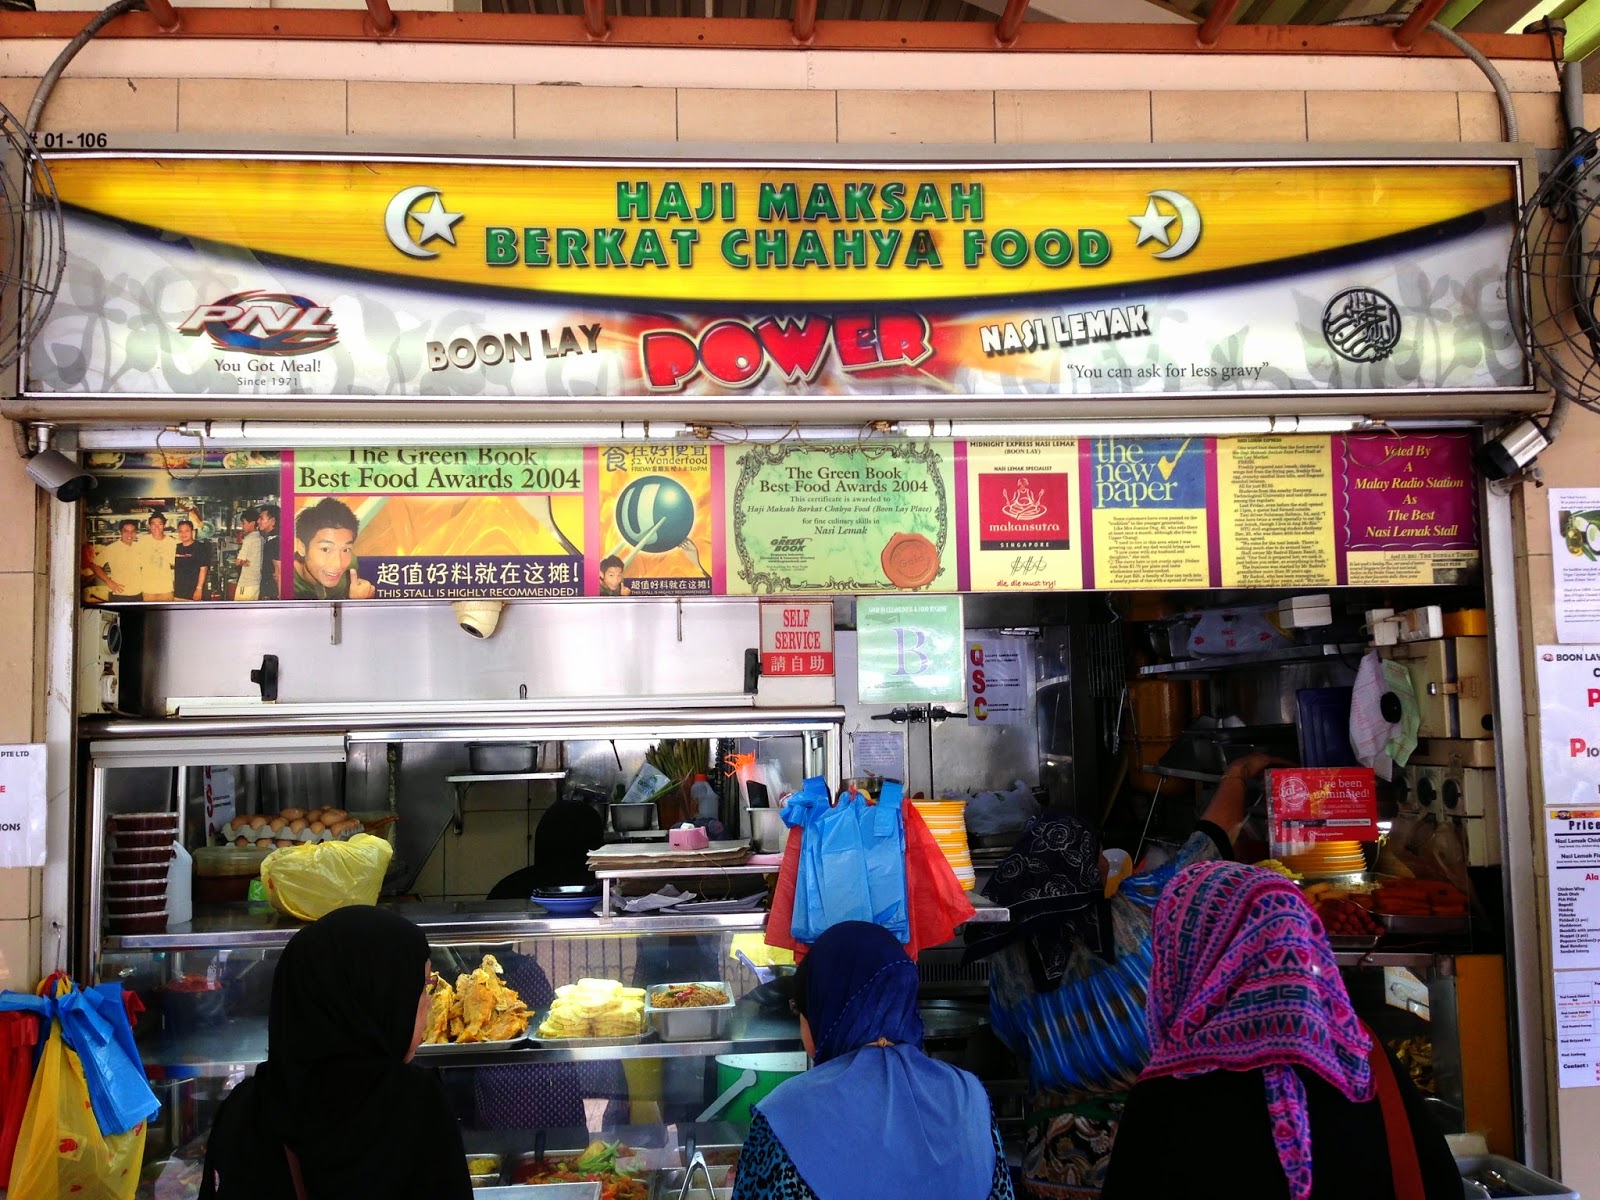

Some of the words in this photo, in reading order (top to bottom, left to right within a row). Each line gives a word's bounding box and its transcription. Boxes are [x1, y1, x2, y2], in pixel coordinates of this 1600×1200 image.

[44, 132, 107, 148] 01-106
[615, 181, 736, 222] HAJI
[757, 182, 984, 223] MAKSAH
[484, 226, 700, 268] BERKAT
[720, 227, 944, 268] CHAHYA
[963, 227, 1112, 267] FOOD
[176, 303, 338, 338] PNL
[979, 318, 1050, 358] NASI
[1052, 304, 1152, 348] LEMAK
[426, 331, 533, 371] BOON
[540, 322, 602, 360] LAY
[640, 312, 936, 391] POWER
[214, 358, 242, 373] You
[247, 358, 276, 373] Got
[281, 358, 322, 373] Meal!
[1067, 363, 1115, 379] “You
[1117, 367, 1134, 378] can
[1137, 363, 1161, 378] ask
[1163, 364, 1188, 378] for
[1191, 363, 1217, 377] less
[1221, 361, 1269, 382] gravy”
[237, 377, 267, 387] Since
[270, 376, 299, 387] 1971
[396, 449, 468, 465] Green
[477, 449, 538, 465] Book
[1096, 436, 1143, 463] the
[1384, 445, 1413, 456] Voted
[1416, 445, 1431, 458] By
[645, 457, 707, 465] Wonderfood
[1403, 461, 1413, 472] A
[299, 466, 350, 489] Best
[358, 466, 418, 489] Food
[426, 466, 513, 489] Awards
[521, 466, 580, 489] 2004
[785, 467, 812, 479] The
[818, 467, 860, 479] Green
[865, 467, 902, 479] Book
[1096, 463, 1157, 482] new
[759, 480, 790, 493] Best
[795, 480, 830, 493] Food
[835, 480, 887, 493] Awards
[892, 480, 928, 493] 2004
[1354, 478, 1389, 491] Malay
[1392, 477, 1424, 489] Radio
[1426, 477, 1464, 488] Station
[1096, 482, 1178, 508] paper
[1402, 494, 1418, 504] As
[1387, 510, 1409, 521] The
[1411, 510, 1435, 521] Best
[814, 526, 835, 535] Nasi
[838, 526, 868, 535] Lemak
[989, 522, 1060, 531] makansutra
[1365, 526, 1391, 537] Nasi
[1393, 525, 1431, 537] Lemak
[1433, 525, 1458, 536] Stall
[1042, 580, 1056, 589] try!
[377, 589, 401, 598] THIS
[403, 589, 434, 598] STALL
[435, 589, 445, 598] IS
[447, 589, 487, 598] HIGHLY
[489, 588, 579, 598] RECOMMENDED!
[783, 609, 809, 627] SELF
[775, 631, 821, 649] SERVICE
[889, 626, 929, 677] B
[970, 644, 984, 668] Q
[1556, 653, 1583, 662] BOON
[771, 655, 825, 672] 請自助
[972, 670, 985, 694] S
[974, 697, 988, 721] C
[1319, 780, 1336, 788] I've
[1339, 779, 1363, 788] been
[1313, 789, 1369, 798] nominated!
[1585, 873, 1599, 881] Ala
